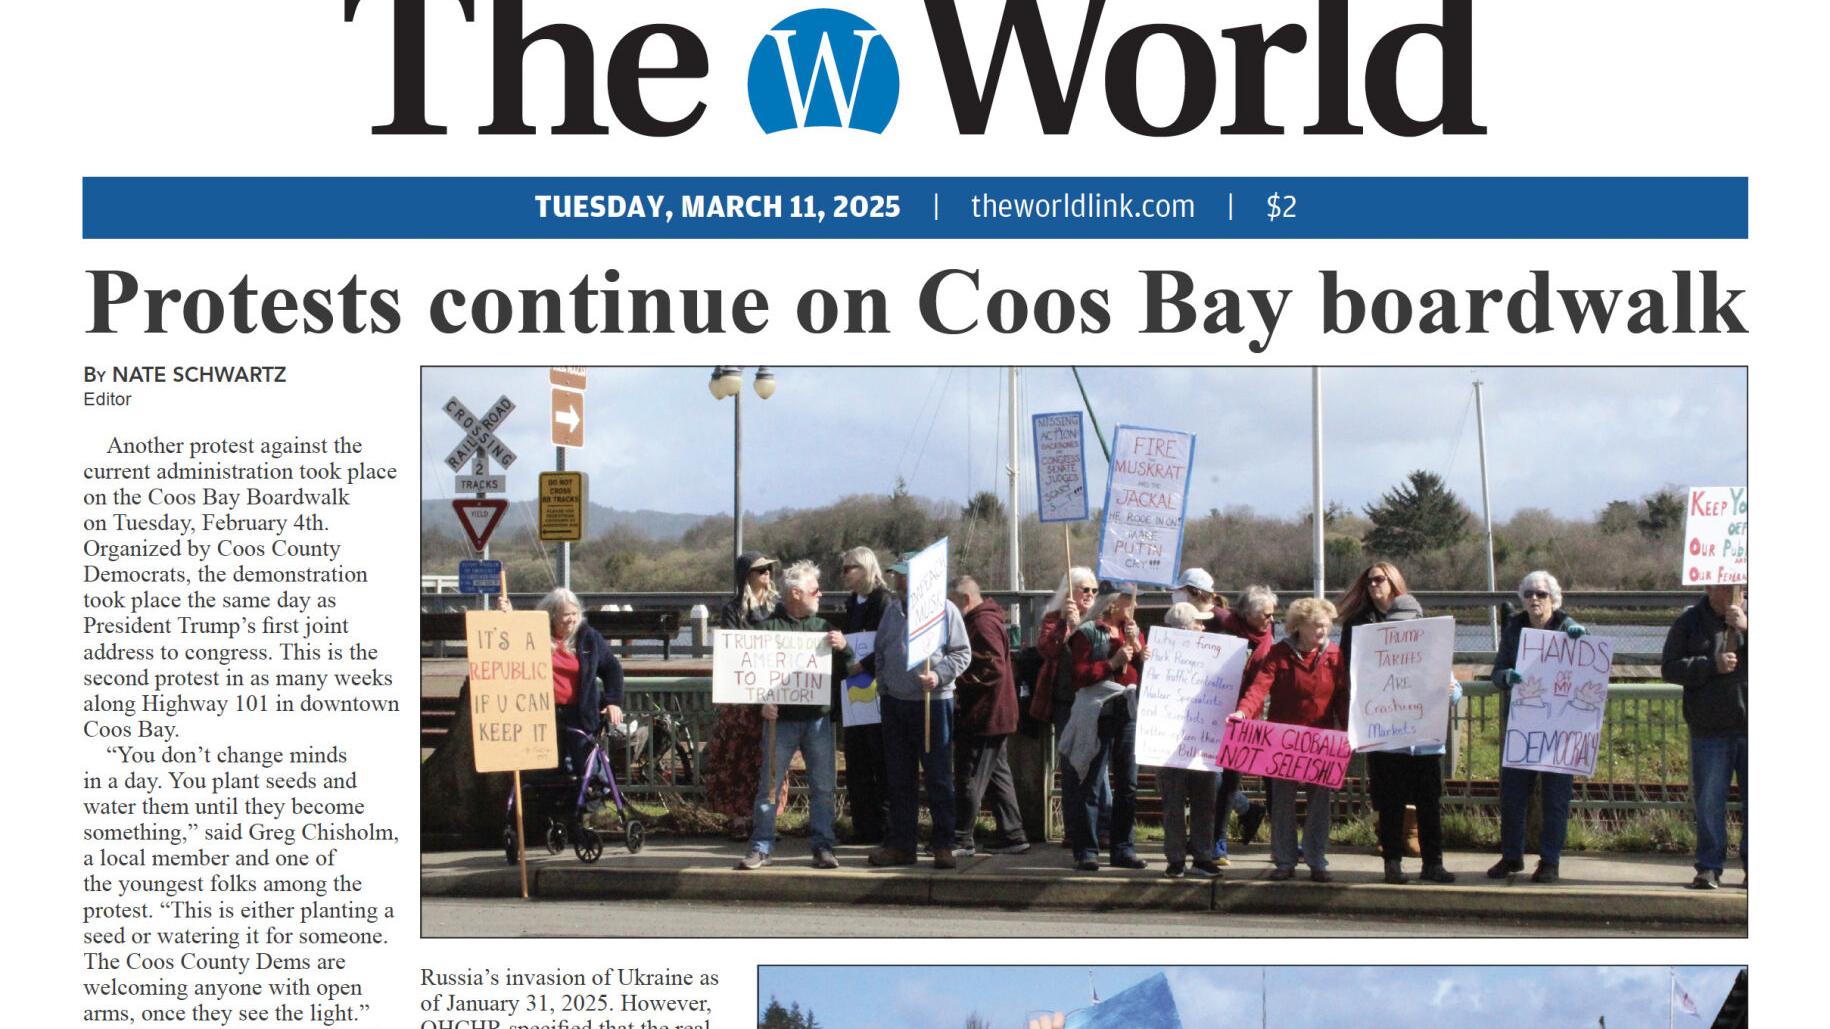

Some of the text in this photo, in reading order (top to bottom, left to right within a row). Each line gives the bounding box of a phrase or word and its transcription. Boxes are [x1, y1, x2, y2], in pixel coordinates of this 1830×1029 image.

[345, 0, 709, 137] The
[924, 0, 1487, 137] World
[535, 192, 1297, 223] TUESDAY, MARCH 11, 2025 theworldlink.com $2
[85, 269, 1749, 353] Protests continue on Coos Bay boardwalk
[114, 366, 165, 383] NATE
[174, 366, 286, 383] SCHWARTZ
[84, 392, 132, 406] Editor
[446, 401, 513, 467] CROSSING
[107, 436, 362, 458] Another protest against the
[1134, 437, 1176, 459] FIRE
[84, 462, 396, 484] current administration took place
[475, 464, 484, 475] 2
[1115, 459, 1186, 480] MUSKRAT
[461, 479, 498, 490] TRACKS
[84, 488, 349, 510] on the Coos Bay Boardwalk
[1116, 489, 1177, 510] JACKAL
[1691, 490, 1728, 516] KEEP
[84, 539, 340, 561] Organized by Coos County
[1114, 540, 1162, 557] PUTIN
[1689, 537, 1716, 556] OUR
[526, 632, 536, 650] A
[722, 633, 772, 650] TRUMP
[741, 652, 818, 669] AMERICA
[1521, 633, 1611, 674] HANDS
[470, 661, 547, 681] REPUBLIC
[734, 671, 823, 690] TO PUTIN
[1556, 670, 1573, 682] OFF
[1554, 682, 1572, 695] MY
[475, 692, 549, 714] IF U CAN
[84, 721, 178, 742] Coos Bay.
[479, 723, 547, 742] KEEP IT
[1228, 719, 1272, 746] THINK
[218, 746, 283, 768] change
[290, 746, 346, 763] minds
[1220, 744, 1345, 786] NOT SELFISHLY
[206, 823, 242, 840] said
[249, 824, 295, 845] Greg
[302, 823, 398, 841] Chisholm,
[84, 953, 345, 974] The Coos County Dems are
[506, 968, 585, 985] invasion
[592, 968, 614, 985] of
[618, 968, 694, 985] Ukraine
[700, 974, 718, 985] as
[84, 1010, 134, 1022] arms,
[142, 1010, 185, 1021] once
[193, 1004, 232, 1026] they
[240, 1010, 268, 1021] see
[275, 1004, 303, 1021] the
[421, 994, 711, 1016] of January 31, 2025. However,
